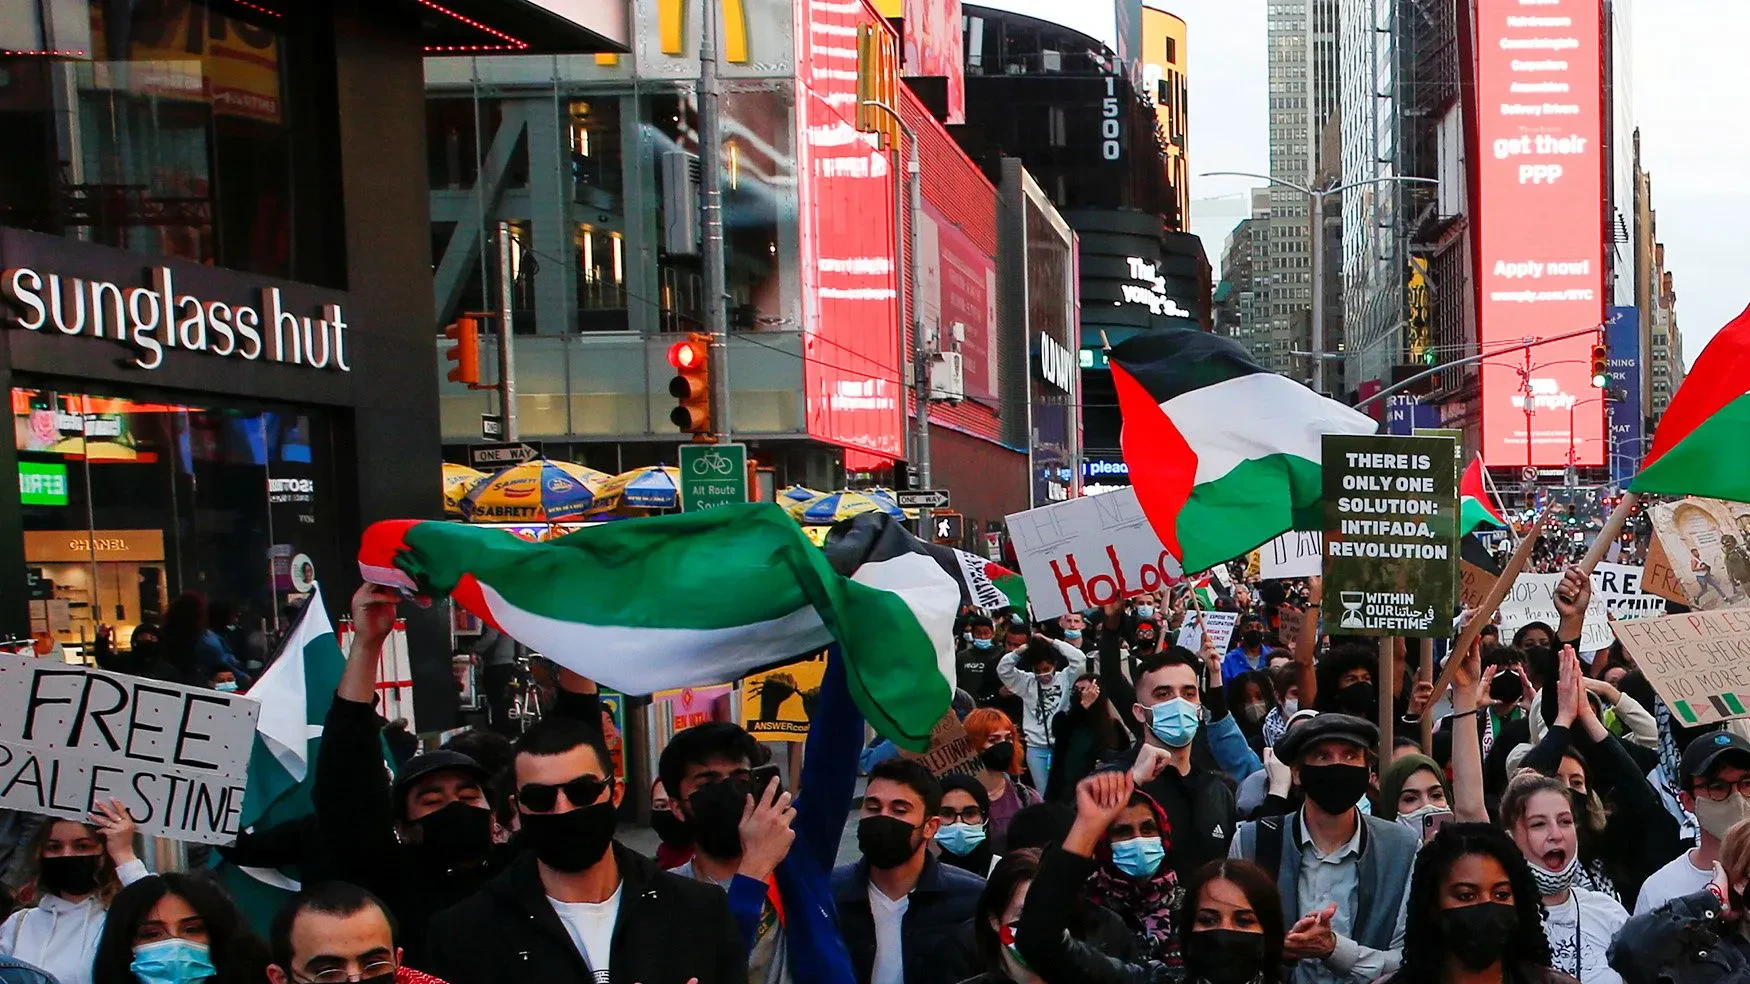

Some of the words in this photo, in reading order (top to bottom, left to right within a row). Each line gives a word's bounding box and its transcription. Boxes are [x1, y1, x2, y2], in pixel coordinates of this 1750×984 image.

[1493, 135, 1531, 159] get
[1535, 134, 1587, 154] their
[1518, 164, 1563, 184] PPP
[1494, 260, 1542, 277] Apply
[1547, 260, 1589, 275] now!
[12, 266, 262, 370] sunglass
[271, 286, 351, 372] hut
[1605, 359, 1635, 367] RNING
[480, 450, 500, 461] ONE
[510, 448, 533, 459] WAY
[1346, 453, 1408, 469] THERE
[1412, 454, 1430, 470] IS
[692, 486, 706, 495] Alt
[708, 486, 735, 496] Route
[1342, 475, 1393, 491] ONLY
[1395, 476, 1434, 492] ONE
[901, 495, 917, 504] ONE
[925, 494, 942, 504] WAY
[1338, 497, 1438, 515] SOLUTION:
[477, 506, 537, 518] SABRETT
[1341, 520, 1435, 539] INTIFADA,
[69, 539, 129, 551] CHANEL
[1329, 541, 1447, 560] REVOLUTION
[1366, 592, 1414, 605] WITHIN
[1366, 604, 1393, 616] OUR
[1607, 598, 1666, 620] ESTINE
[1366, 617, 1427, 630] LIFETIME
[1624, 618, 1685, 646] FREE
[1645, 646, 1697, 674] SAVE
[1666, 676, 1696, 700] NO
[1696, 666, 1748, 692] MORE
[22, 668, 231, 769] FREE
[0, 744, 246, 835] PALESTINE
